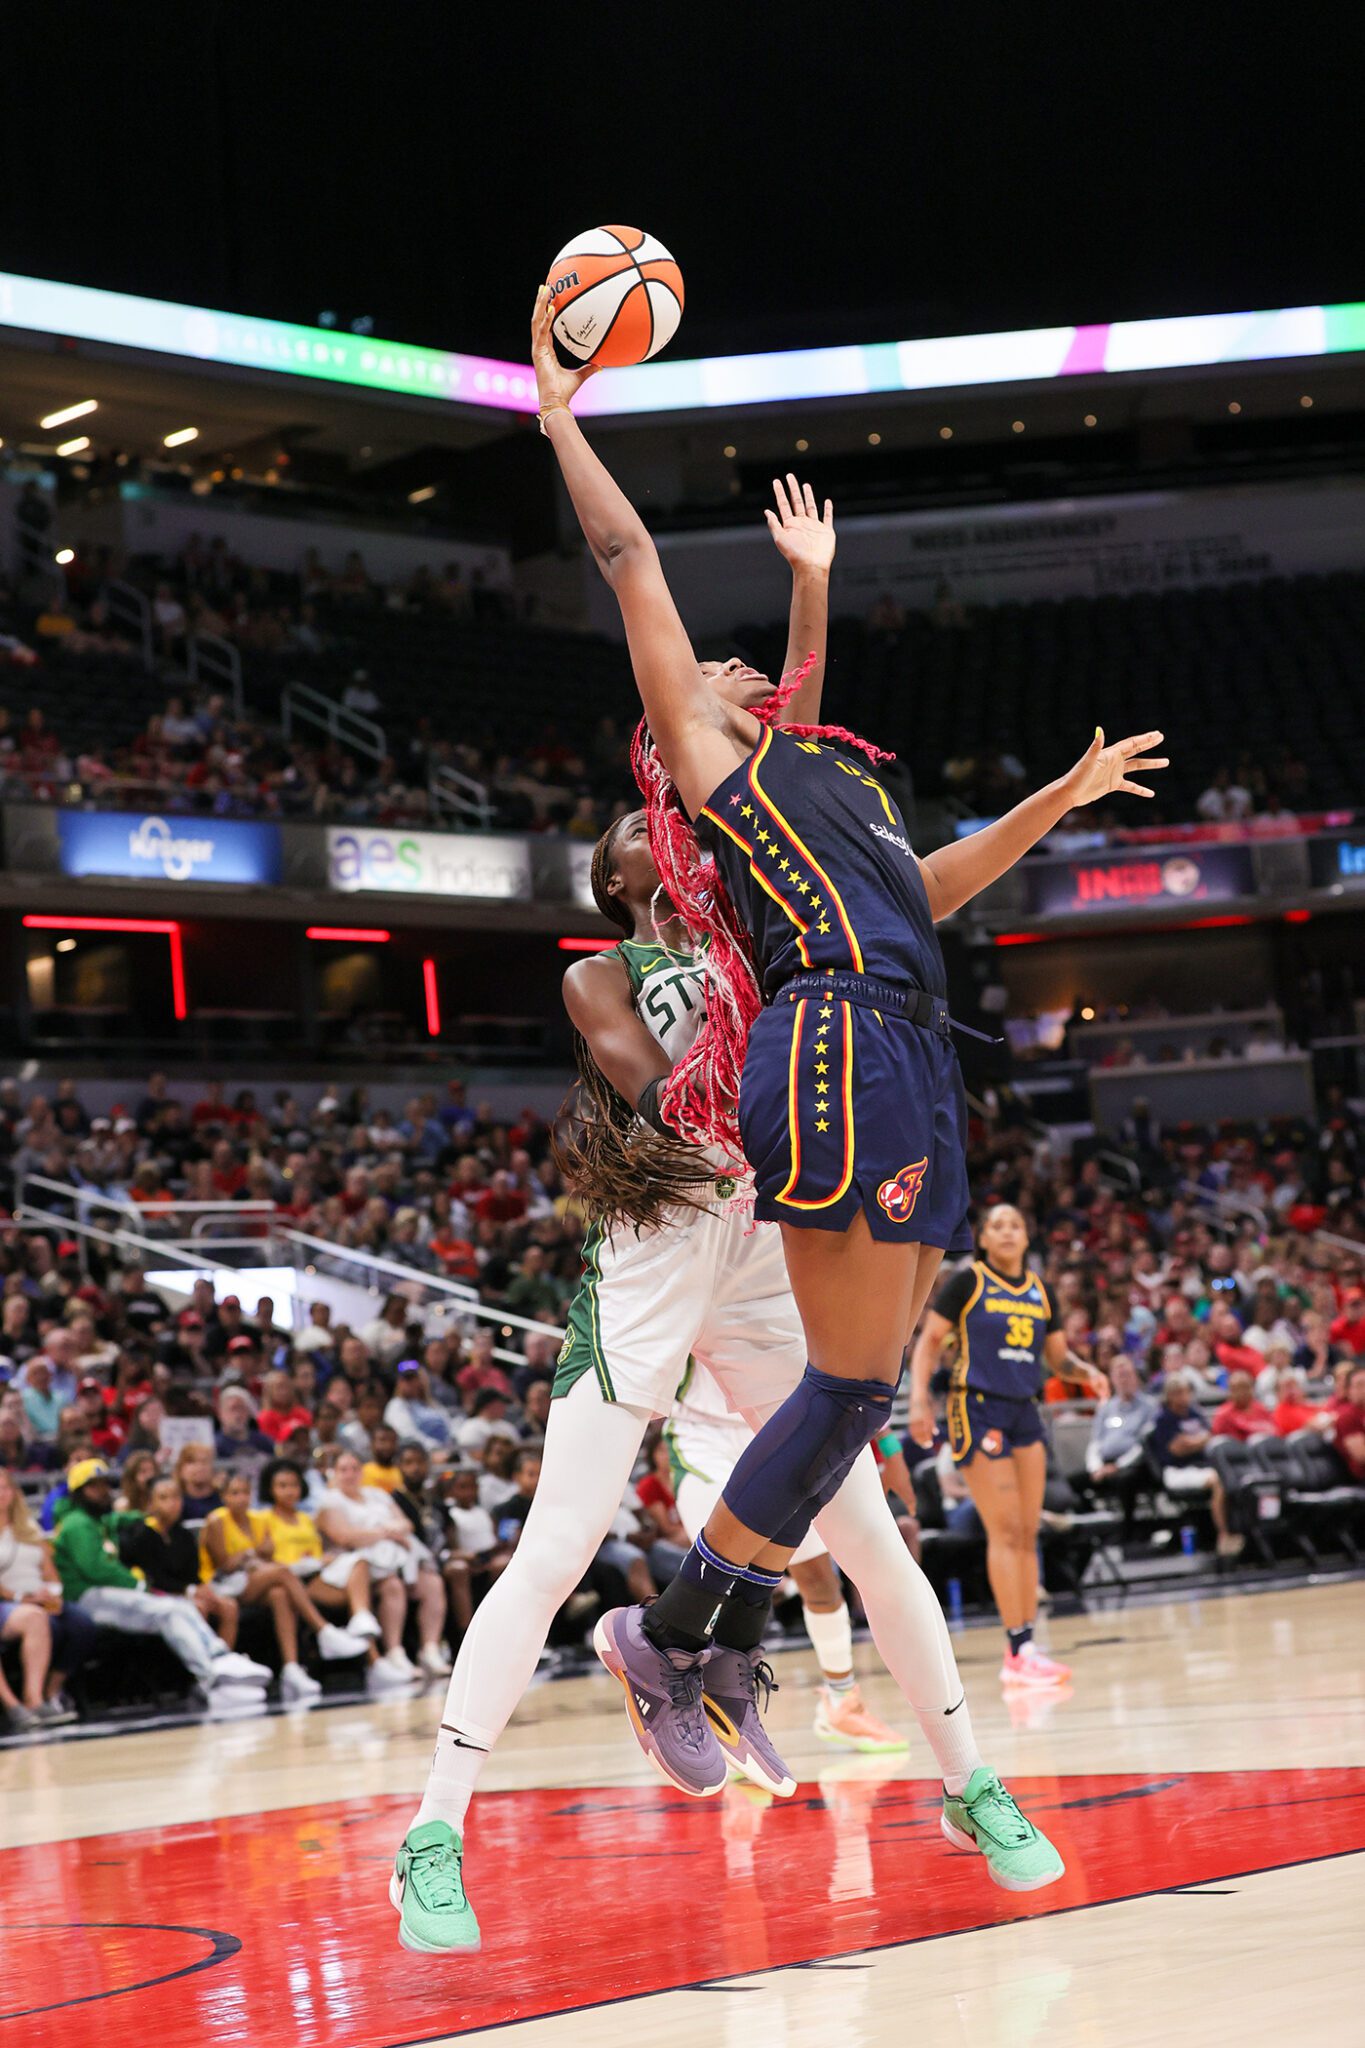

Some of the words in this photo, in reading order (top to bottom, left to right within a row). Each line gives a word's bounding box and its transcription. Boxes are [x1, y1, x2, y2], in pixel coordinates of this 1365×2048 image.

[360, 350, 462, 388] PASTRY
[130, 816, 214, 880] Kroger
[333, 834, 421, 884] aes
[1005, 1315, 1035, 1348] 35
